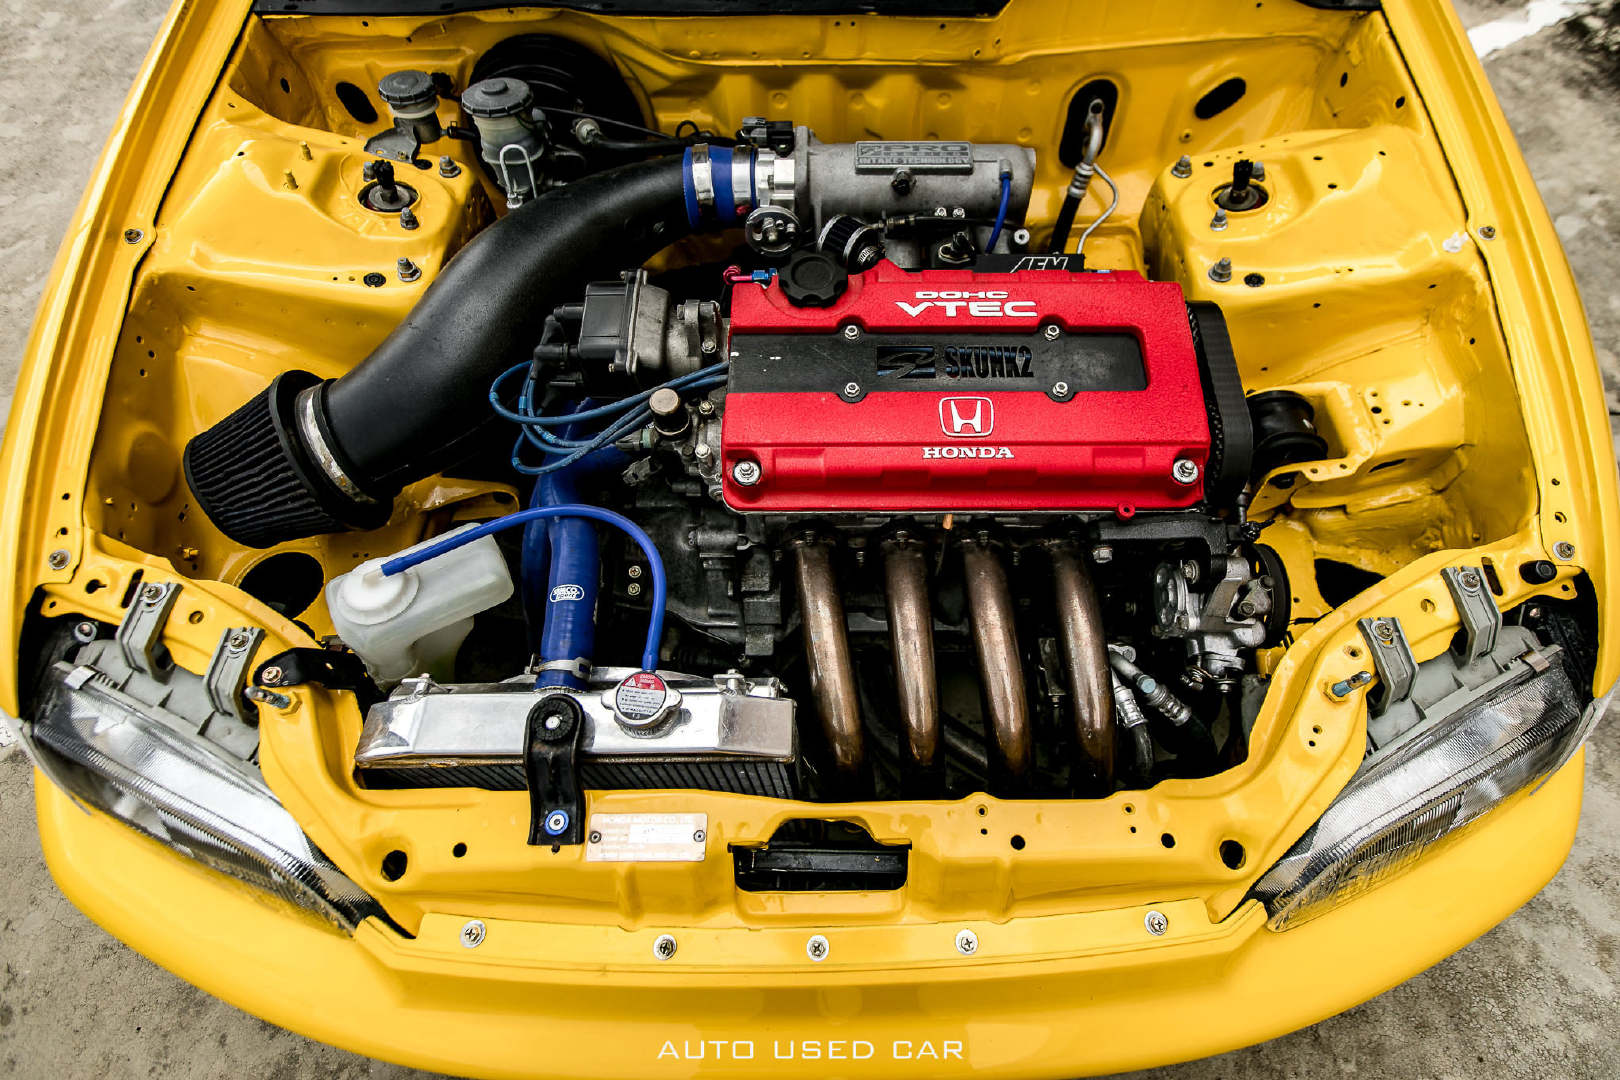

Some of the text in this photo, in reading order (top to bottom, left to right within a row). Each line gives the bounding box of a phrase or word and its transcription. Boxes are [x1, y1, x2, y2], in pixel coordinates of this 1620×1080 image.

[1010, 256, 1068, 273] AEM
[915, 291, 1009, 299] DOHC
[895, 301, 1038, 317] VTEC
[945, 346, 1034, 378] SKUNK2
[922, 447, 1014, 458] HONDA
